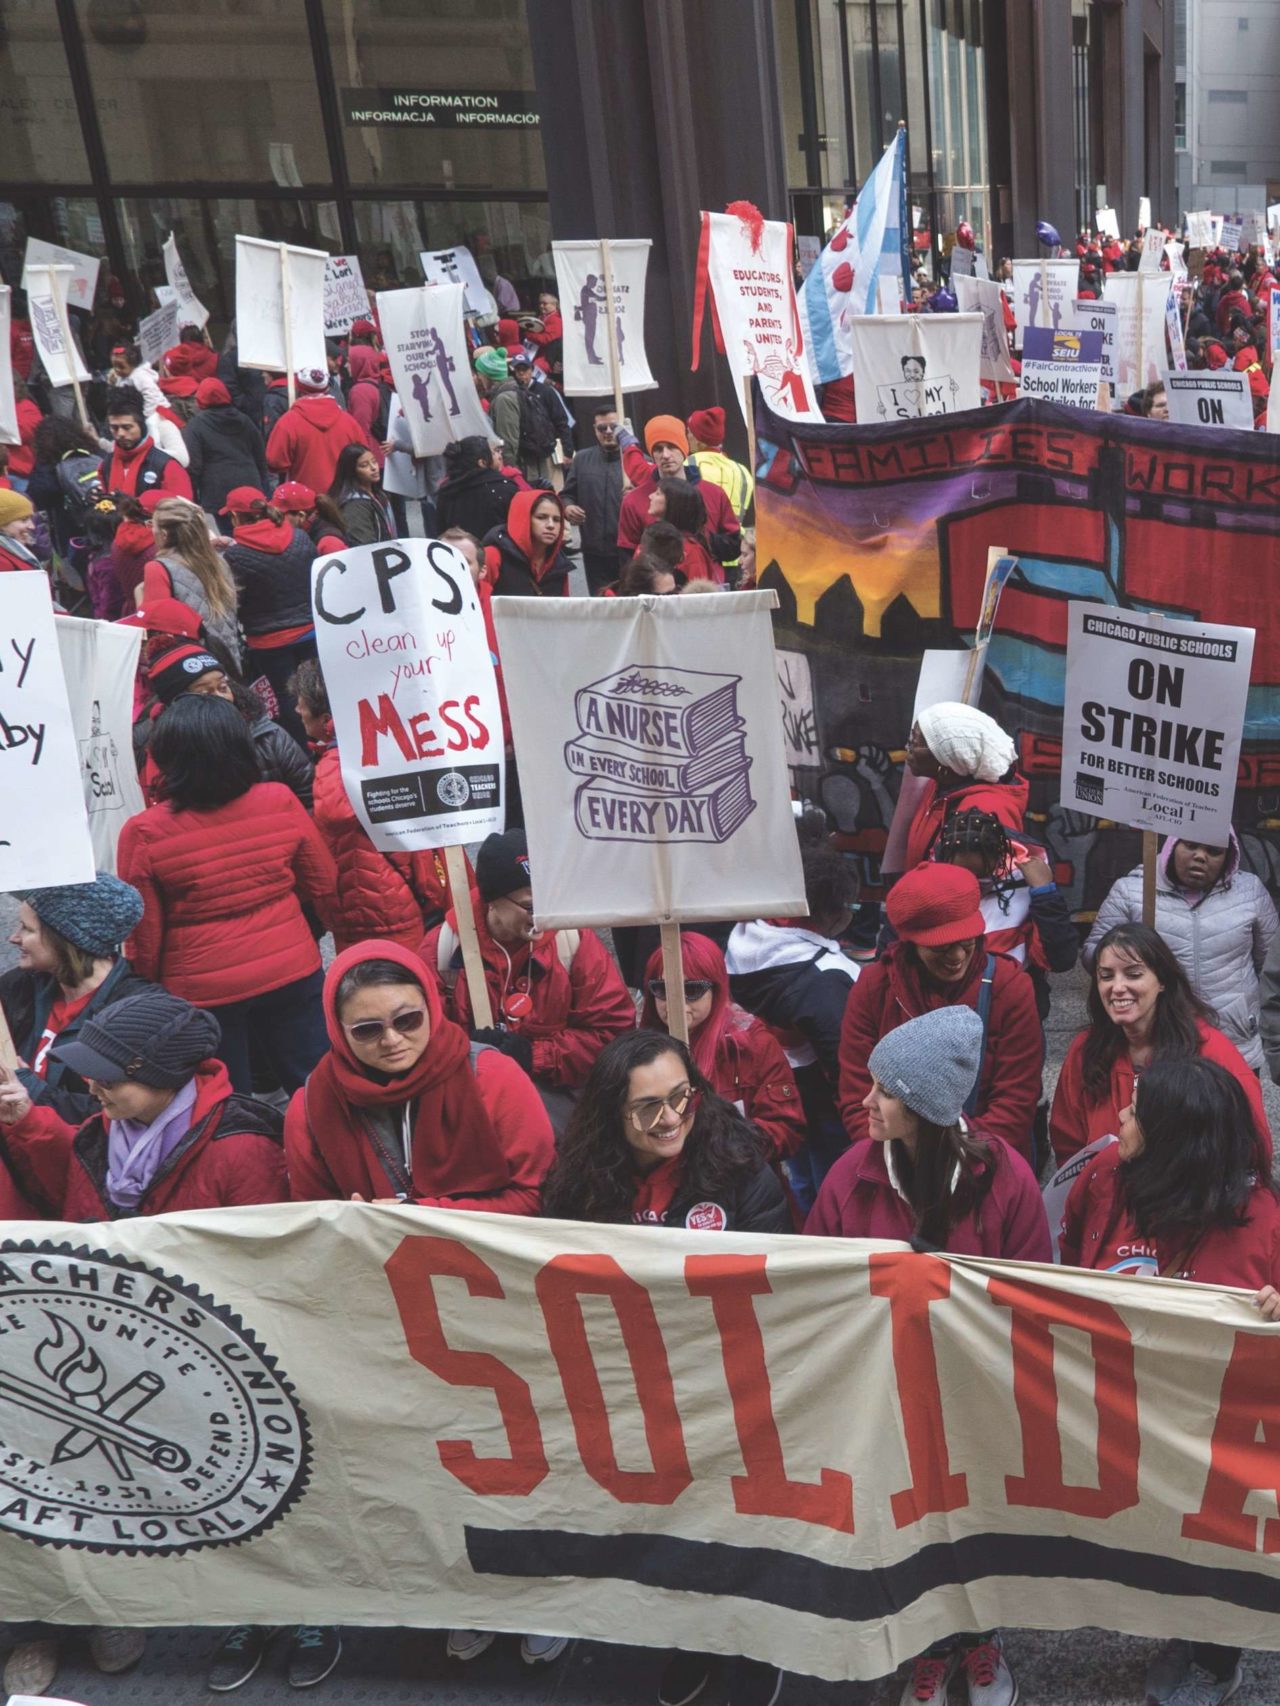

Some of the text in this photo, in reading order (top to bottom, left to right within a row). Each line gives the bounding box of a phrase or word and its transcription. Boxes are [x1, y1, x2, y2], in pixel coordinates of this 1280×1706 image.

[394, 95, 498, 108] INFORMATION
[351, 111, 435, 122] INFORMACJA
[733, 269, 784, 285] EDUCATORS,
[740, 285, 782, 300] STUDENTS,
[757, 302, 773, 313] AND
[749, 318, 782, 331] PARENTS
[1090, 317, 1105, 330] ON
[755, 333, 782, 345] UNITED
[406, 350, 425, 361] OUR
[1052, 348, 1080, 358] SEIU
[1024, 361, 1098, 373] #FairContractNow
[1023, 376, 1098, 394] School Workers
[1172, 379, 1241, 391] CHICAGO PUBLIC SCHOOLS
[891, 386, 943, 406] I MY
[1197, 397, 1224, 424] ON
[801, 427, 1075, 481] FAMILIES
[346, 629, 456, 662] clean up
[1087, 619, 1233, 659] CHICAGO PUBLIC SCHOOLS
[389, 655, 441, 700] your
[1128, 658, 1184, 708] ON
[358, 692, 490, 767] MESS
[586, 697, 682, 750] A NURSE
[1080, 700, 1225, 771] STRIKE
[571, 751, 675, 789] IN EVERY SCHOOL
[1080, 751, 1104, 770] FOR
[1107, 758, 1155, 782] BETTER
[1158, 771, 1220, 797] SCHOOLS
[366, 789, 391, 799] Fighting
[400, 786, 409, 794] the
[471, 783, 496, 791] TEACHERS
[368, 793, 418, 806] schools Chicago's
[1141, 797, 1196, 822] Local 1
[587, 796, 707, 835] EVERY DAY
[406, 825, 434, 835] Federation
[87, 1315, 197, 1377] UNITE
[221, 1343, 296, 1464] UNION
[181, 1411, 229, 1492] DEFEND
[76, 1479, 151, 1500] 1937
[0, 1494, 270, 1541] AFT LOCAL 1
